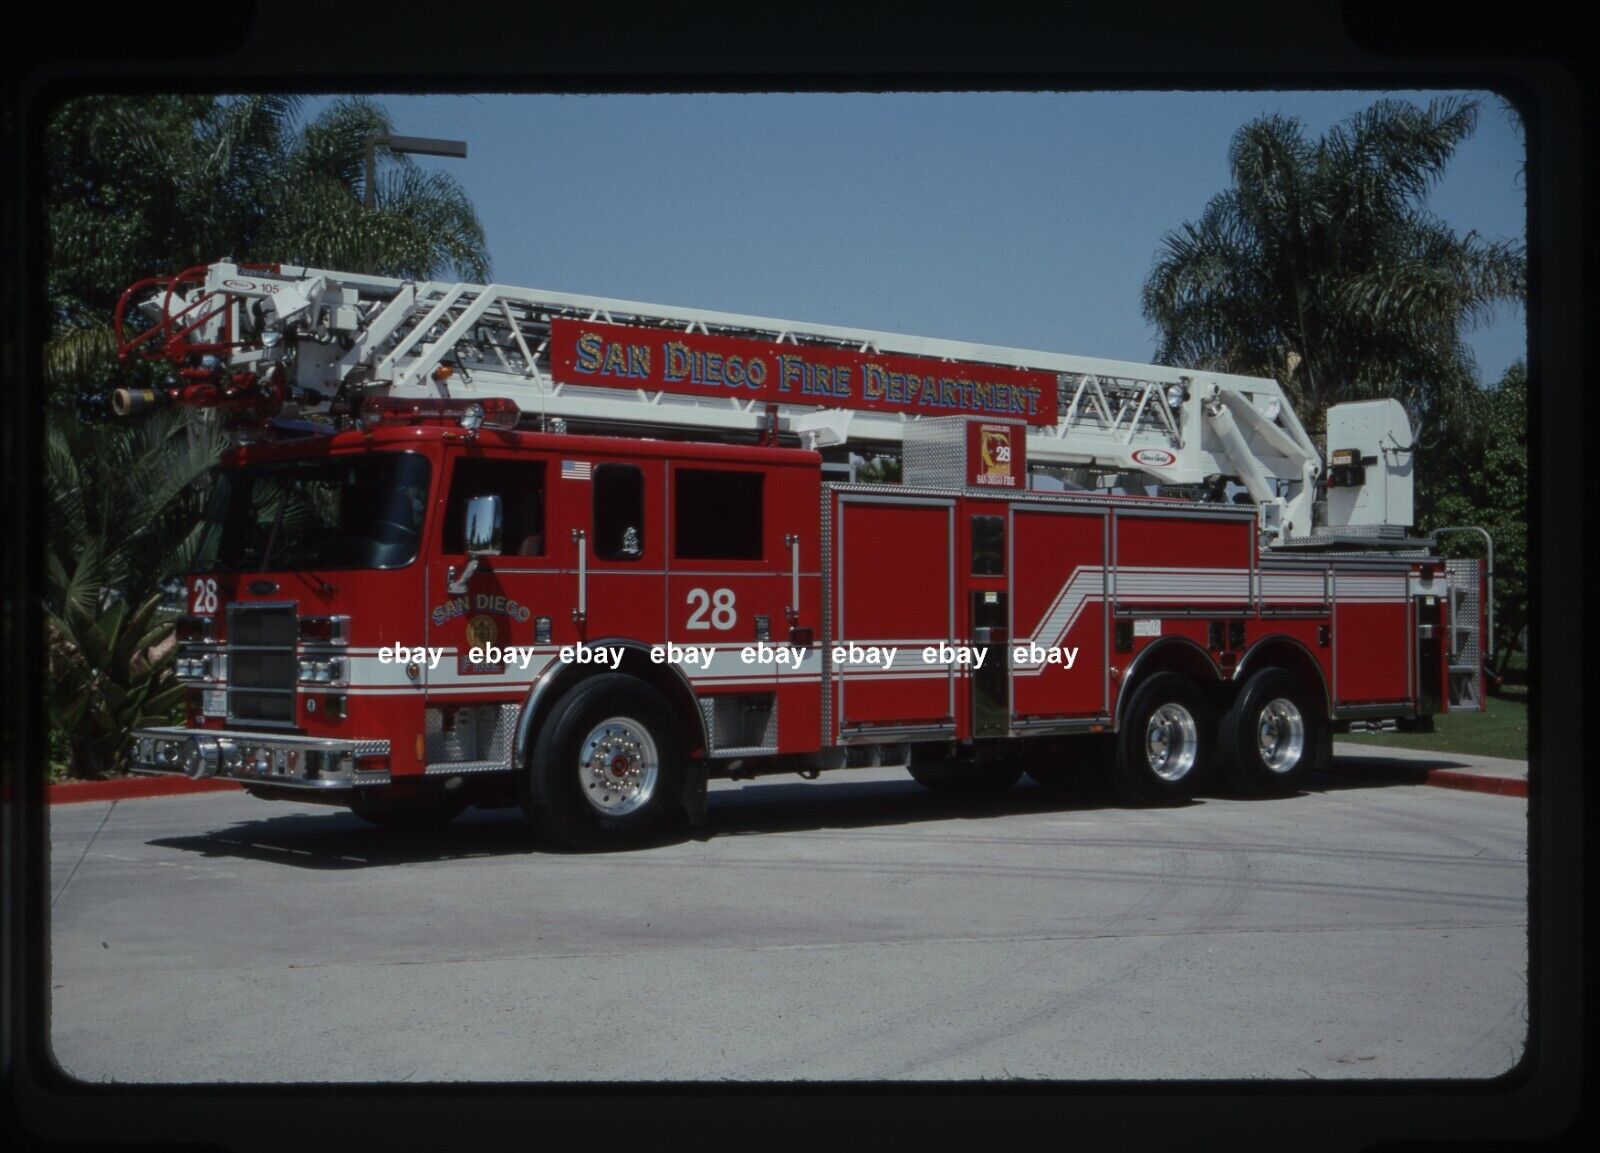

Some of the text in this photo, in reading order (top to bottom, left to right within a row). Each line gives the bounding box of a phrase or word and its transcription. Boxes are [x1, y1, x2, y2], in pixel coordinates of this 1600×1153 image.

[260, 283, 279, 294] 105
[996, 446, 1011, 462] 28
[193, 578, 218, 613] 28
[432, 594, 530, 625] SAN DIEGO
[686, 588, 737, 630] 28
